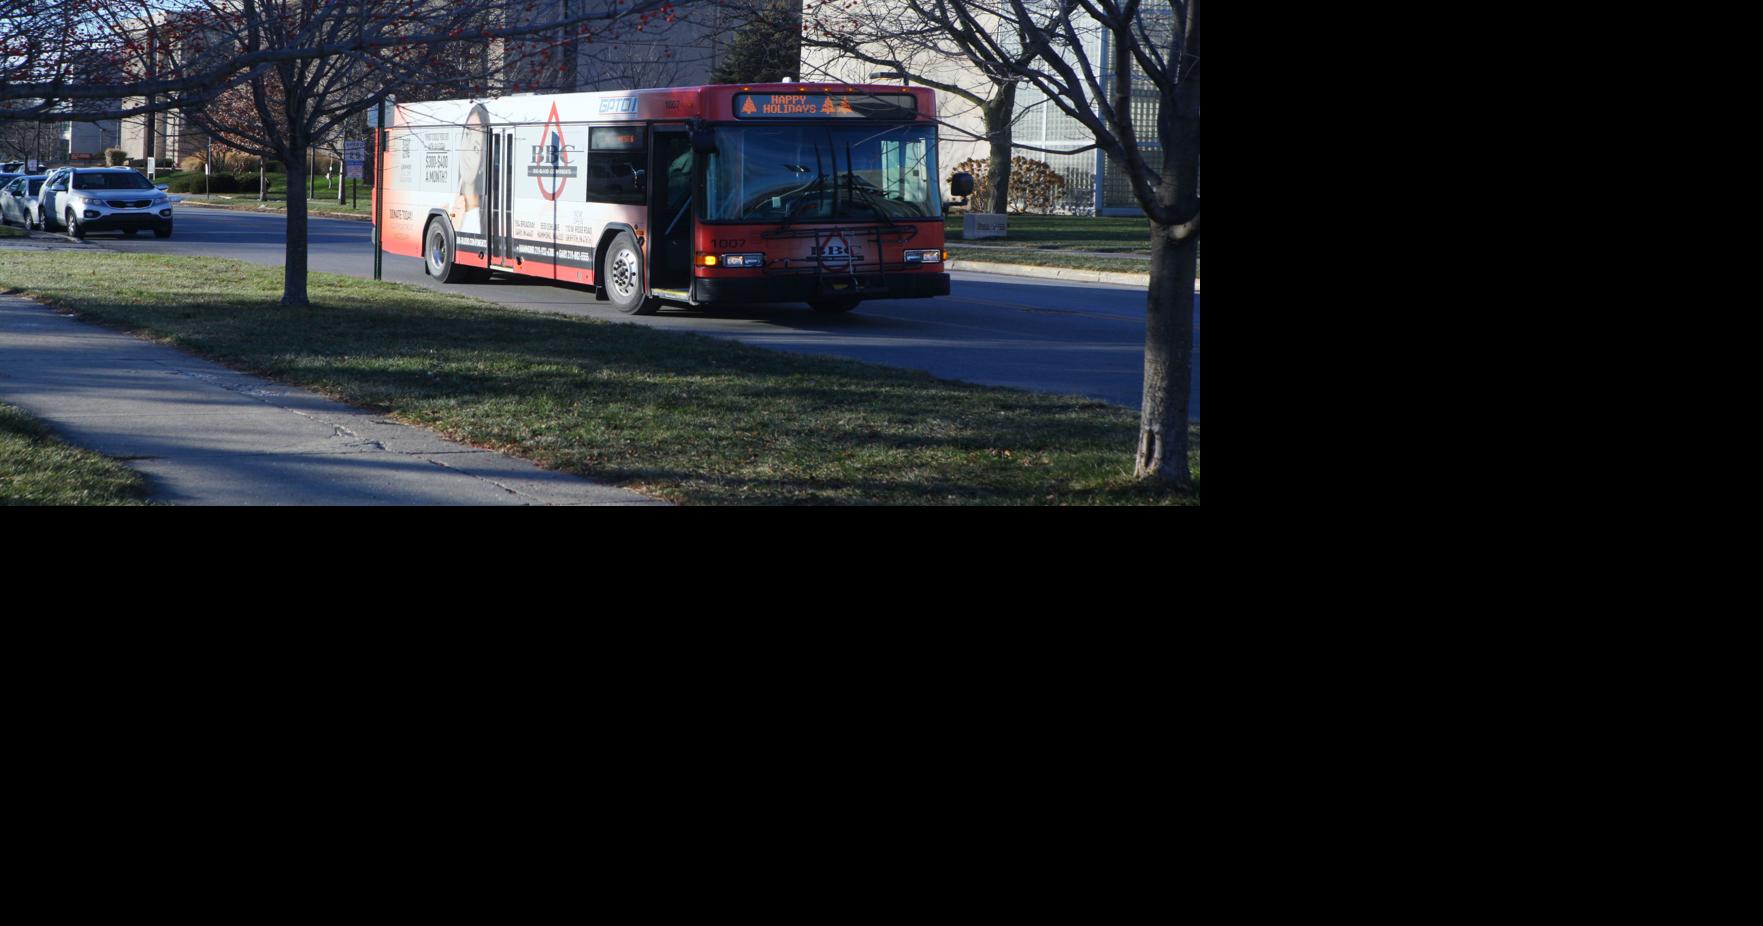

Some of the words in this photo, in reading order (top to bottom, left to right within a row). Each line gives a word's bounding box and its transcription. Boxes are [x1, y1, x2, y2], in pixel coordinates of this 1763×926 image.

[771, 95, 807, 105] HAPPY
[763, 103, 817, 114] HOLIDAYS
[531, 145, 576, 163] BBC
[711, 238, 746, 248] 1007
